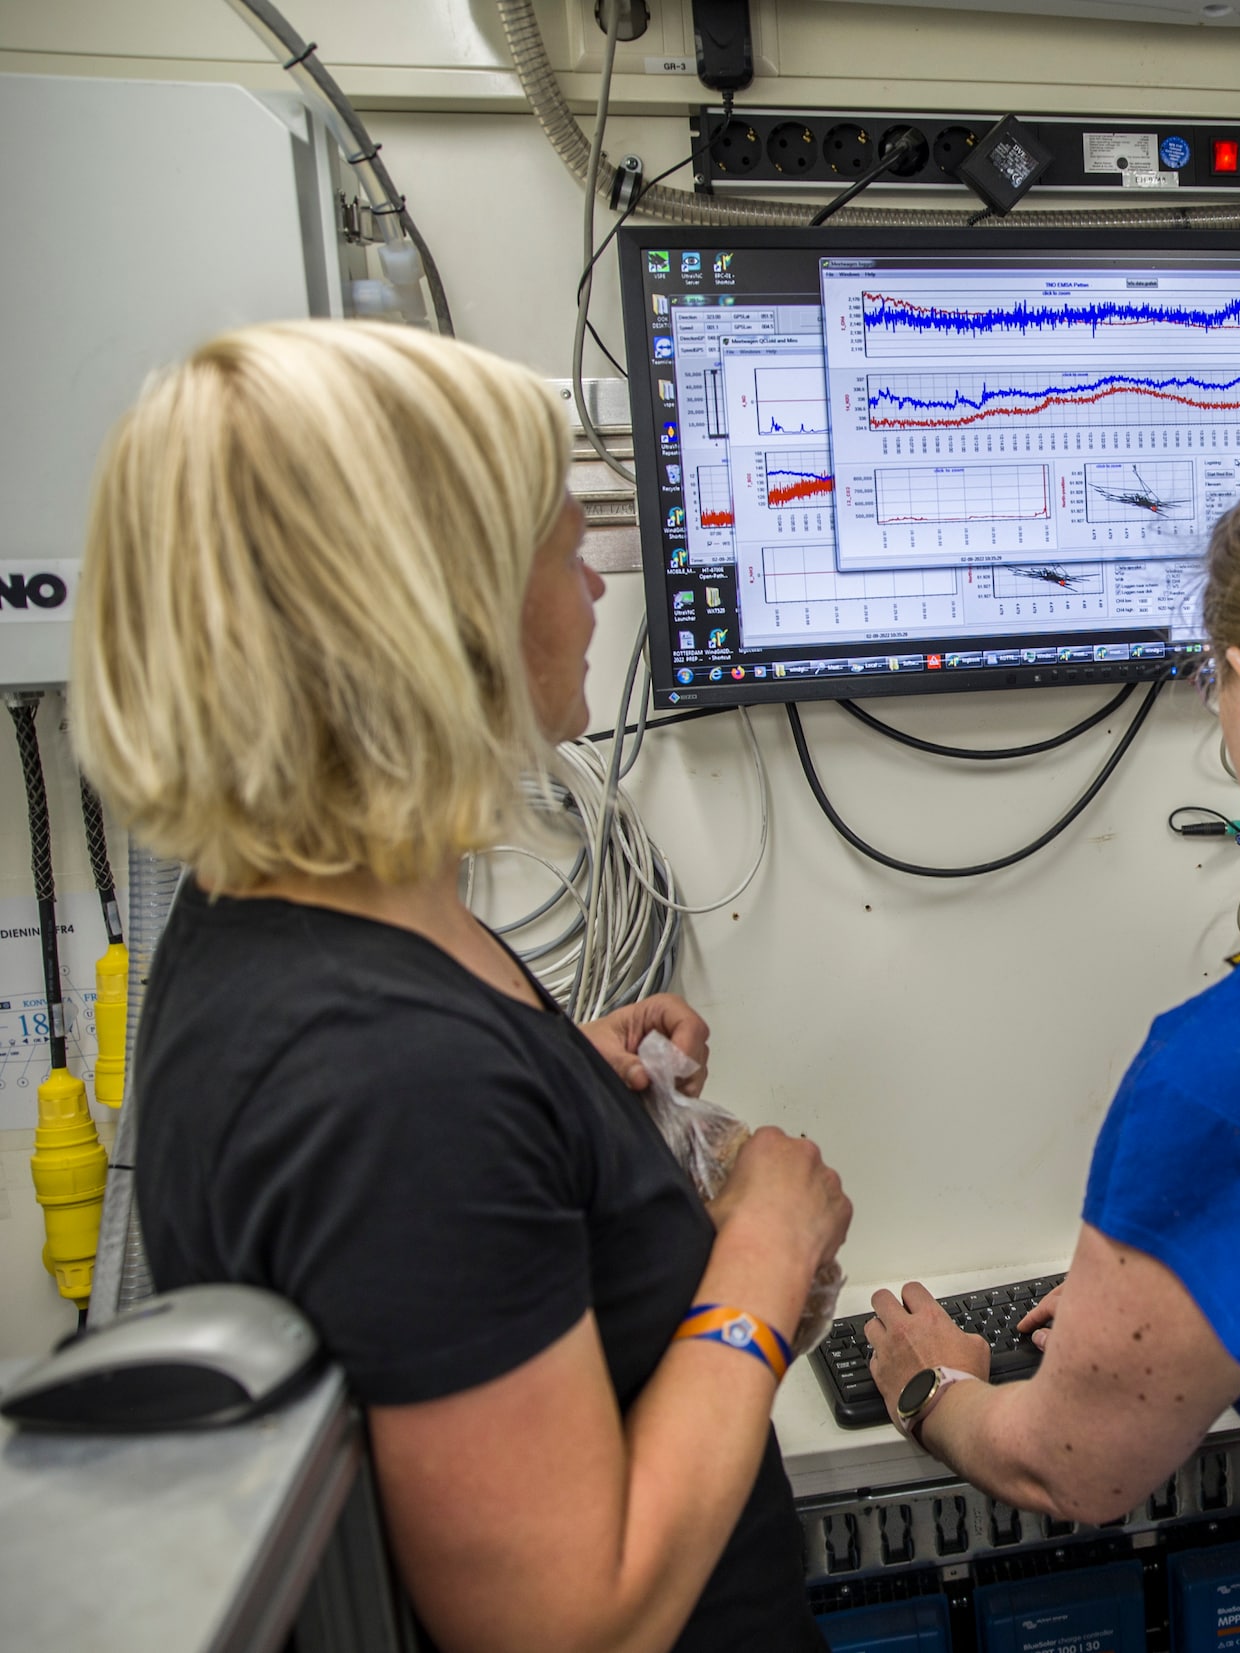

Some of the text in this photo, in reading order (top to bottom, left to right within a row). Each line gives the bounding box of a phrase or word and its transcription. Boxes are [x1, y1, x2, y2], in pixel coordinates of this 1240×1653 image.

[664, 62, 686, 70] GR-3
[1024, 1630, 1114, 1650] BlueSolar charge controller
[1086, 1640, 1100, 1650] 30
